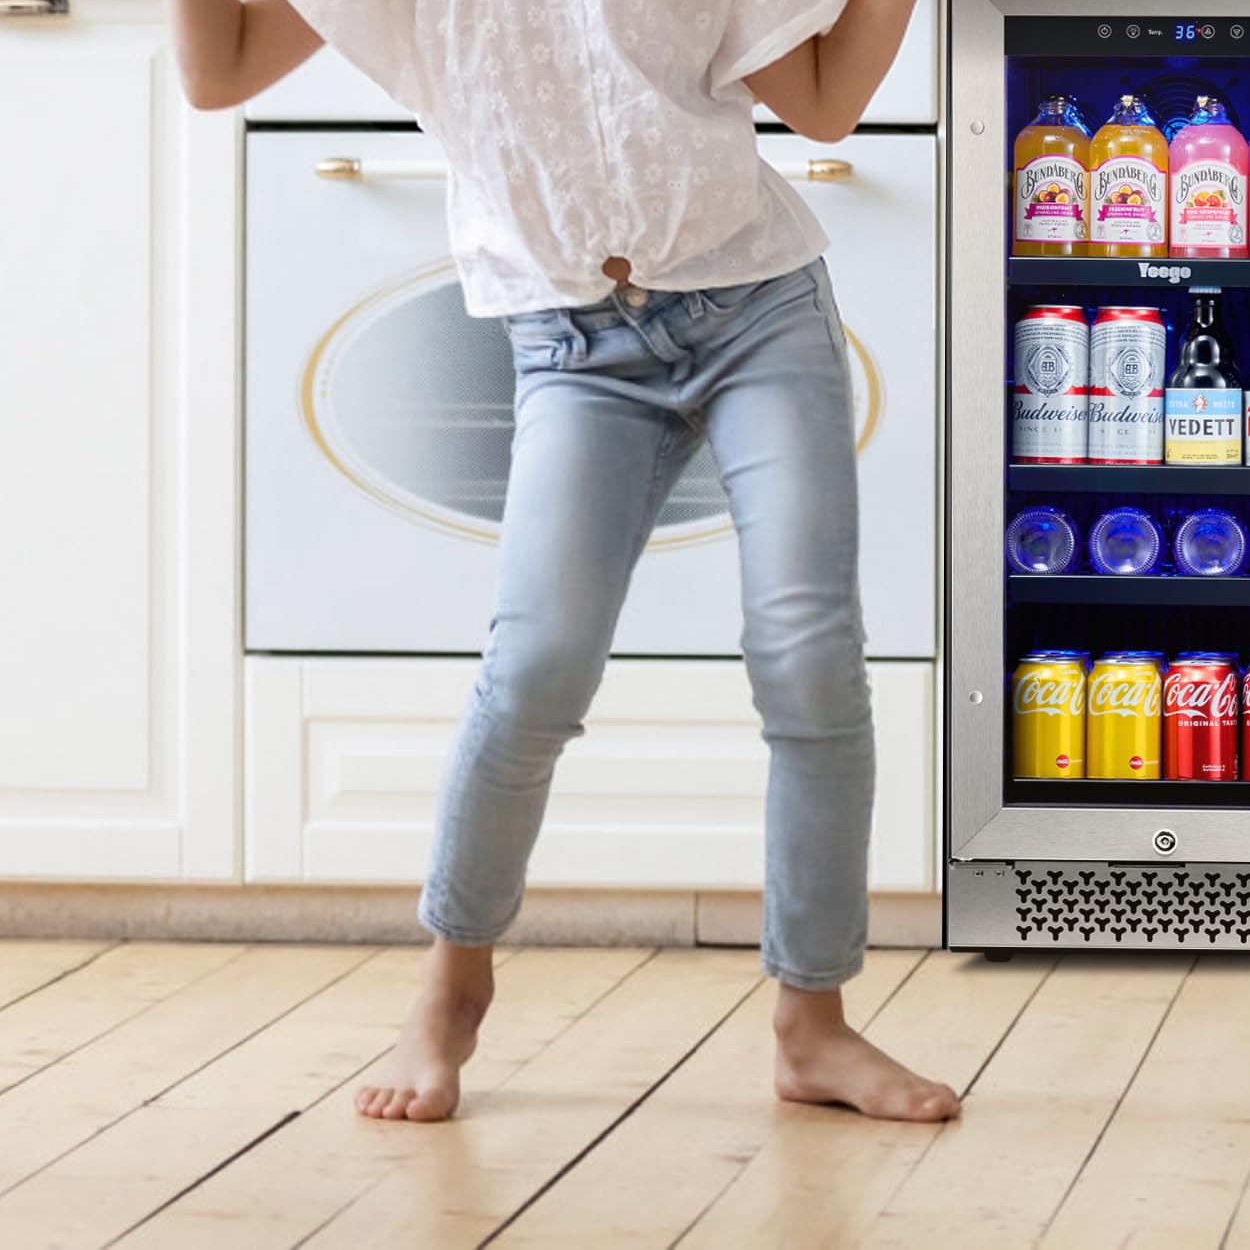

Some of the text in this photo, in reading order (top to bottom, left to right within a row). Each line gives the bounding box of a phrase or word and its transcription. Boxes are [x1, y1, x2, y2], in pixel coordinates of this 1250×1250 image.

[1175, 25, 1195, 39] 36
[1021, 164, 1088, 200] BUNDABERG
[1095, 166, 1162, 202] BUNDABERG
[1176, 168, 1243, 205] BUNDABERG
[1138, 262, 1191, 284] Yeego
[1169, 418, 1235, 436] VEDETT
